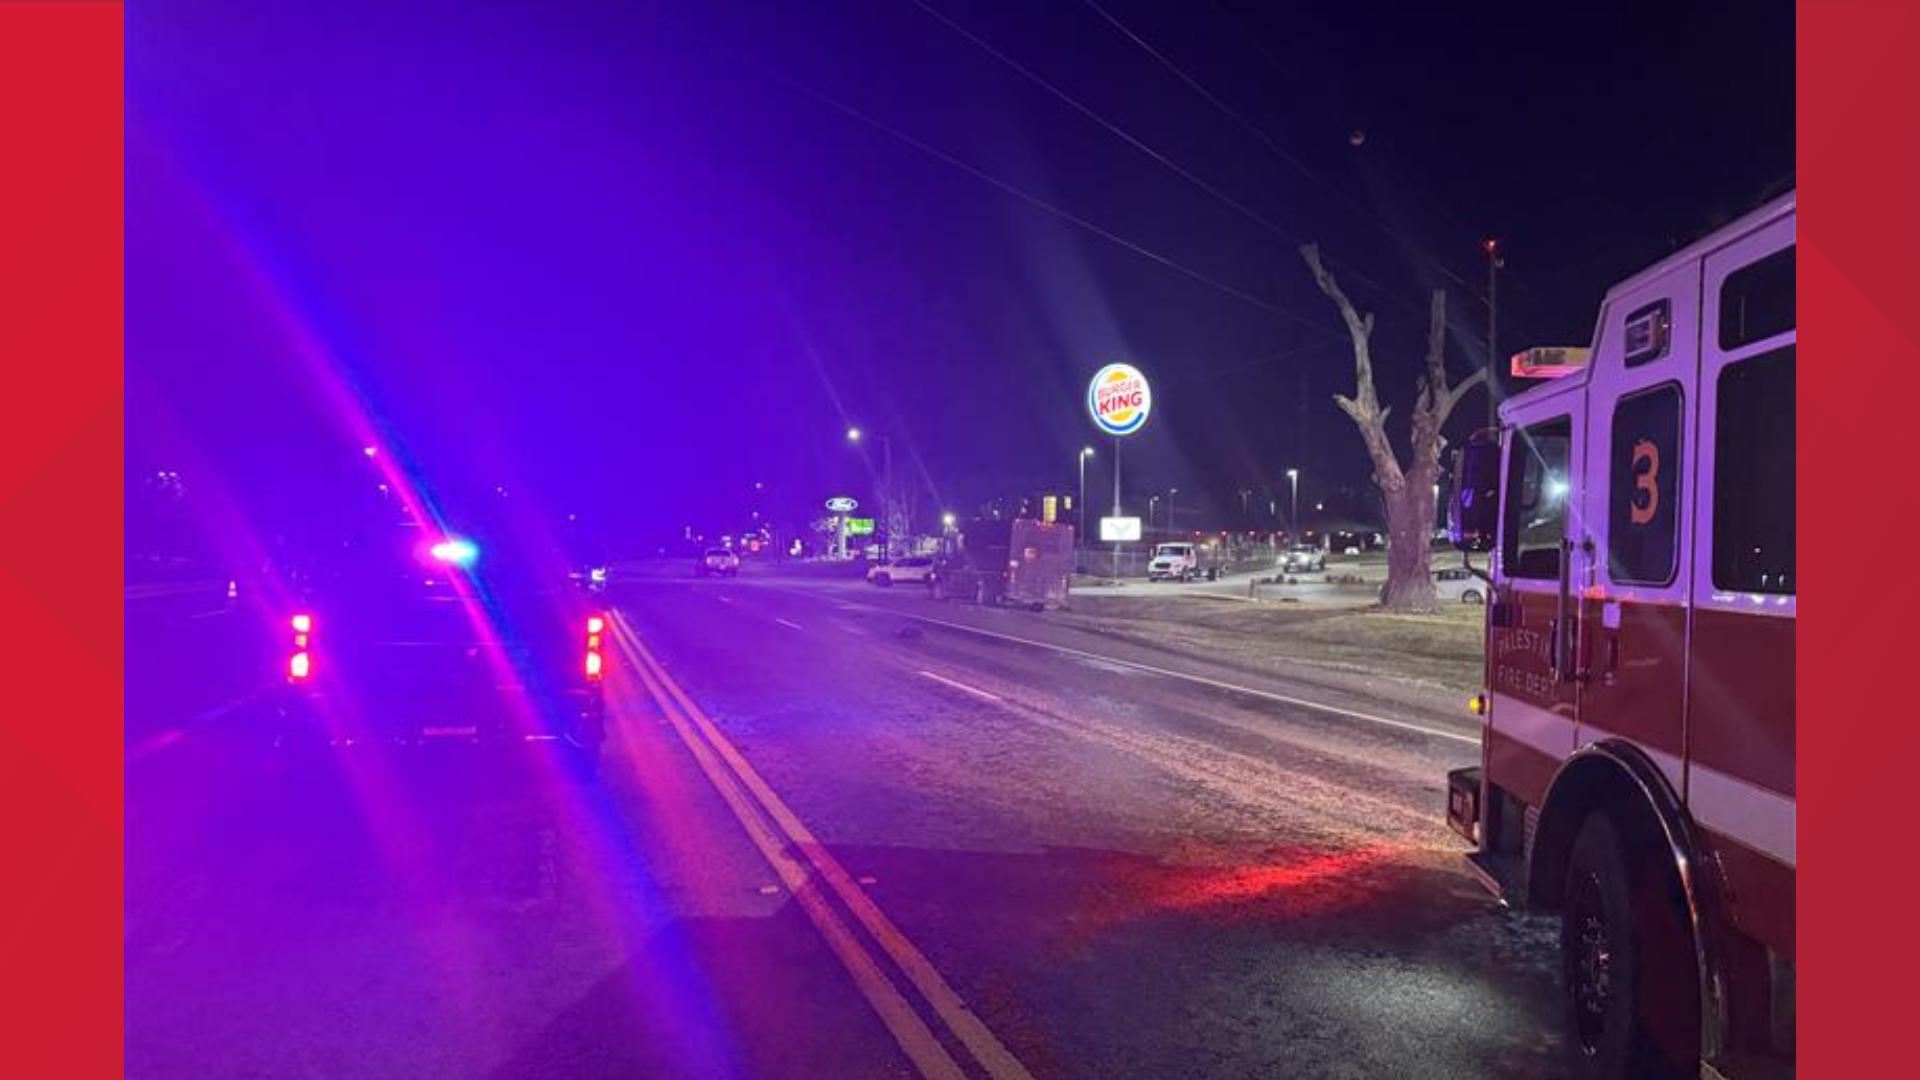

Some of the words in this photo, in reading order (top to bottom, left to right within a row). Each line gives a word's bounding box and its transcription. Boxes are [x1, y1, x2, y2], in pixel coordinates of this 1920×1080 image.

[1098, 379, 1141, 400] BURGER
[1099, 391, 1142, 415] KING
[1631, 439, 1659, 524] 3
[1499, 665, 1522, 689] FIRE
